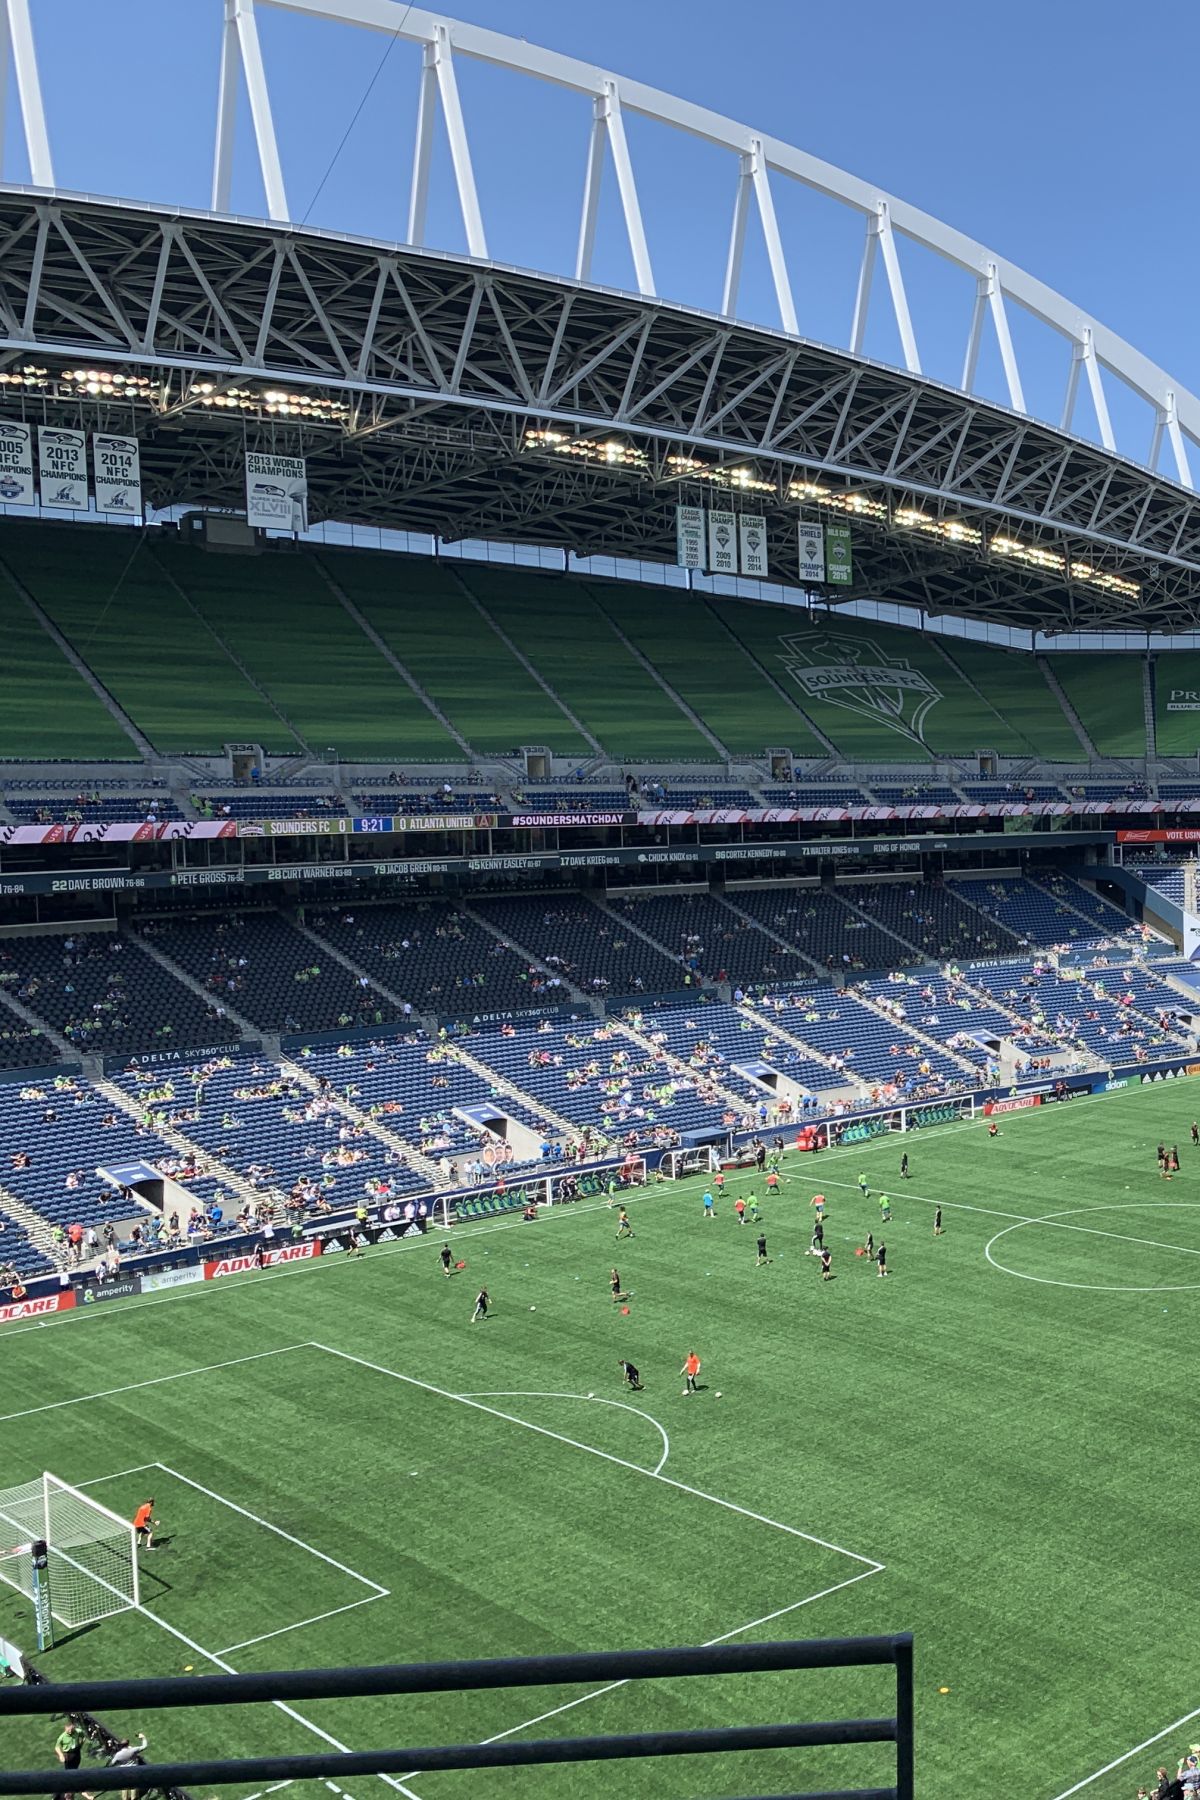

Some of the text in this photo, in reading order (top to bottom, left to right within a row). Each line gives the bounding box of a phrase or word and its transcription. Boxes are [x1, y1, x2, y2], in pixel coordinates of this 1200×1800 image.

[46, 446, 79, 461] 2013
[51, 460, 75, 471] NFC
[101, 453, 132, 467] 2014
[248, 455, 303, 469] 2013 WORLD
[40, 469, 87, 482] CHAMPIONS
[106, 466, 129, 478] NFC
[248, 464, 304, 479] CHAMPIONS
[96, 475, 140, 488] CHAMPIONS
[249, 501, 291, 515] XLVIII
[711, 517, 734, 526] CHAMPS
[742, 521, 764, 530] CHAMPS
[800, 529, 821, 538] SHIELD
[716, 551, 731, 560] 2009
[747, 555, 761, 563] 2011
[716, 560, 731, 568] 2010
[747, 563, 762, 571] 2014
[800, 562, 824, 571] CHAMPS
[806, 673, 927, 690] SOUNDERS FC
[361, 818, 383, 832] 9:21
[399, 817, 474, 830] 0 ATLANTA UNITED
[512, 814, 624, 826] #SOUNDERSMATCHDAY
[270, 819, 346, 834] SOUNDERS FC 0
[811, 846, 830, 855] WALTER
[831, 846, 848, 854] JONES
[873, 844, 889, 852] RING
[900, 843, 920, 851] HONOR
[648, 853, 686, 862] CHUCK KNOX
[726, 850, 747, 859] CORTEZ
[747, 849, 773, 858] KENNEDY
[468, 859, 527, 870] 45 KENNY EASLEY
[560, 856, 606, 866] 17 DAVE KRIEG
[268, 869, 281, 879] 28
[282, 869, 302, 879] CURT
[303, 868, 335, 878] WARNER
[374, 864, 432, 874] 79 JACOB GREEN
[51, 878, 145, 891] 22 DAVE BROWN 76-86
[177, 874, 198, 885] PETE
[199, 873, 227, 884] GROSS
[483, 1012, 513, 1021] DELTA
[142, 1052, 180, 1063] DELTA
[1105, 1080, 1128, 1091] slalom
[992, 1099, 1034, 1113] ADVOCARE
[161, 1271, 197, 1284] amperity
[96, 1284, 134, 1298] amperity
